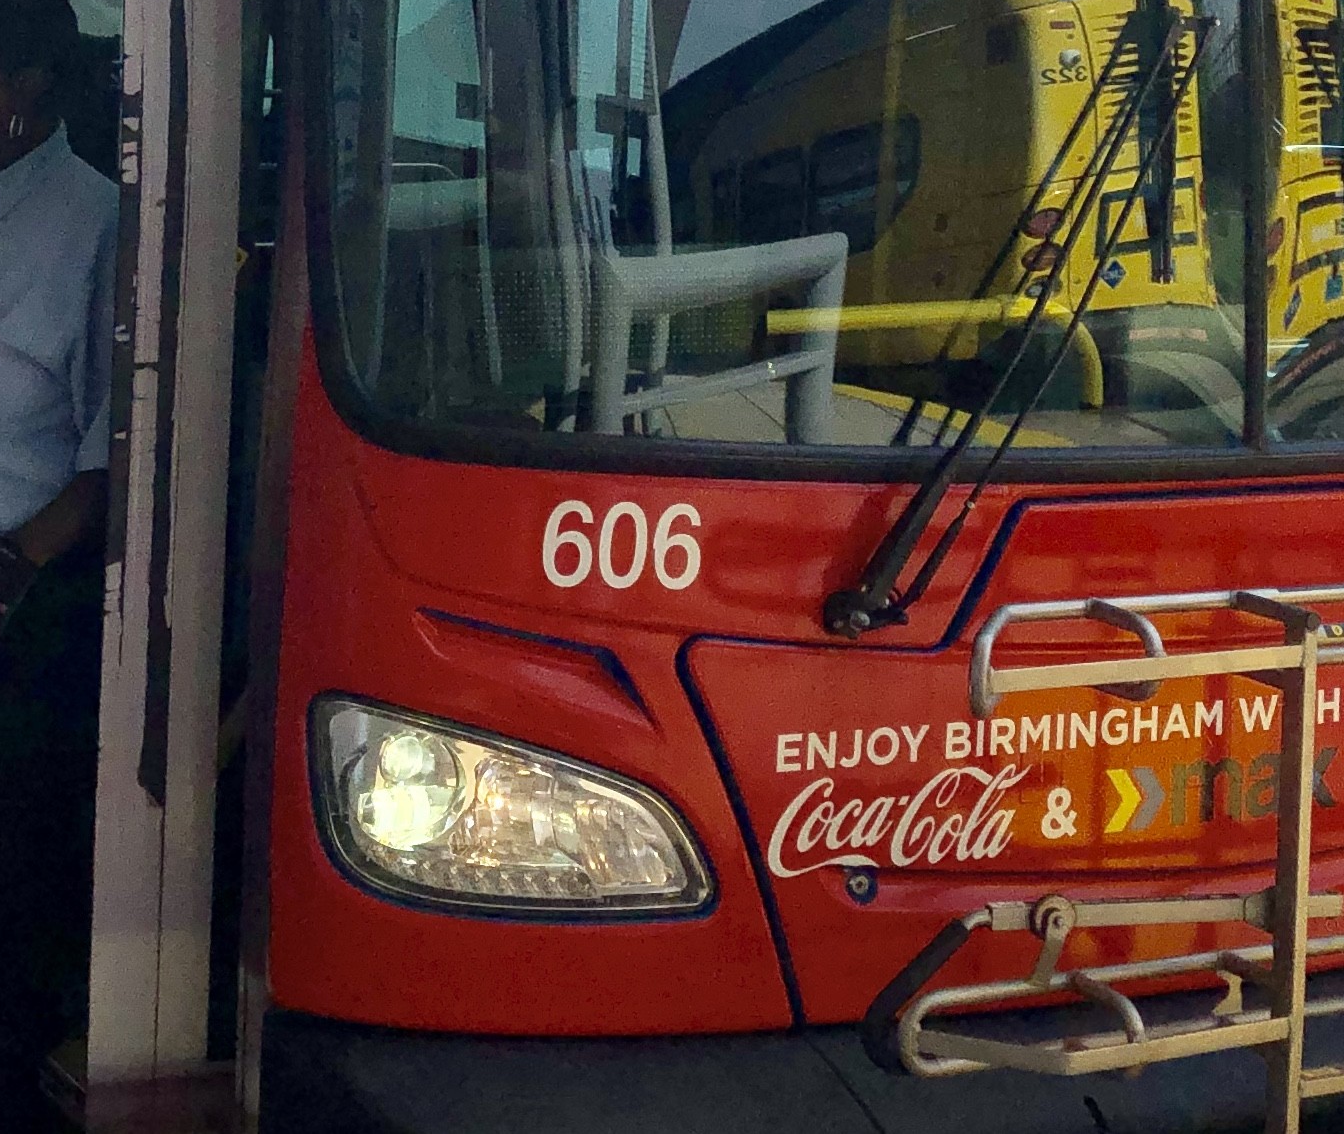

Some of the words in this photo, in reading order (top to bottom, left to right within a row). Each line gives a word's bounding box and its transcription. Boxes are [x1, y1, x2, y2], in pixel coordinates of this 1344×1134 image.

[542, 499, 702, 590] 606
[775, 724, 930, 773] ENJOY
[944, 699, 1224, 760] BIRMINGHAM
[1238, 687, 1341, 734] WH
[767, 763, 1033, 878] Coca-Cola
[1040, 786, 1078, 840] &
